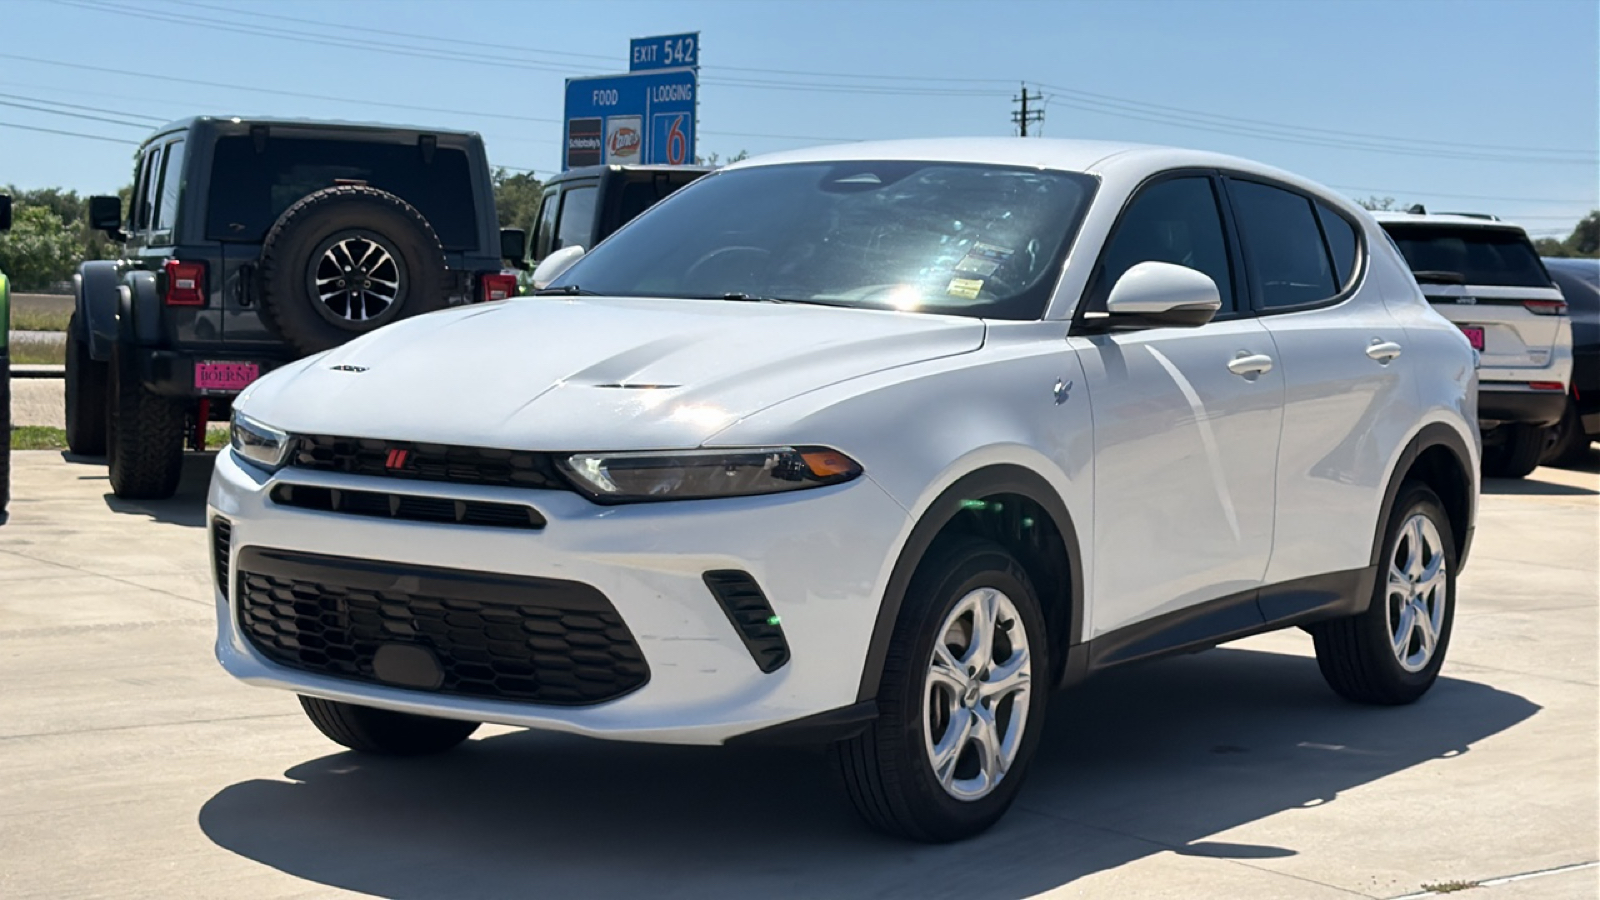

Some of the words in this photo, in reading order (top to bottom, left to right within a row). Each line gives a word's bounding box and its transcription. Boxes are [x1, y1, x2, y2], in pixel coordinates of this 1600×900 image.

[634, 45, 658, 63] EXIT
[664, 38, 694, 64] 542
[593, 89, 619, 106] FOOD
[653, 84, 692, 103] LODGING
[666, 114, 685, 165] 6
